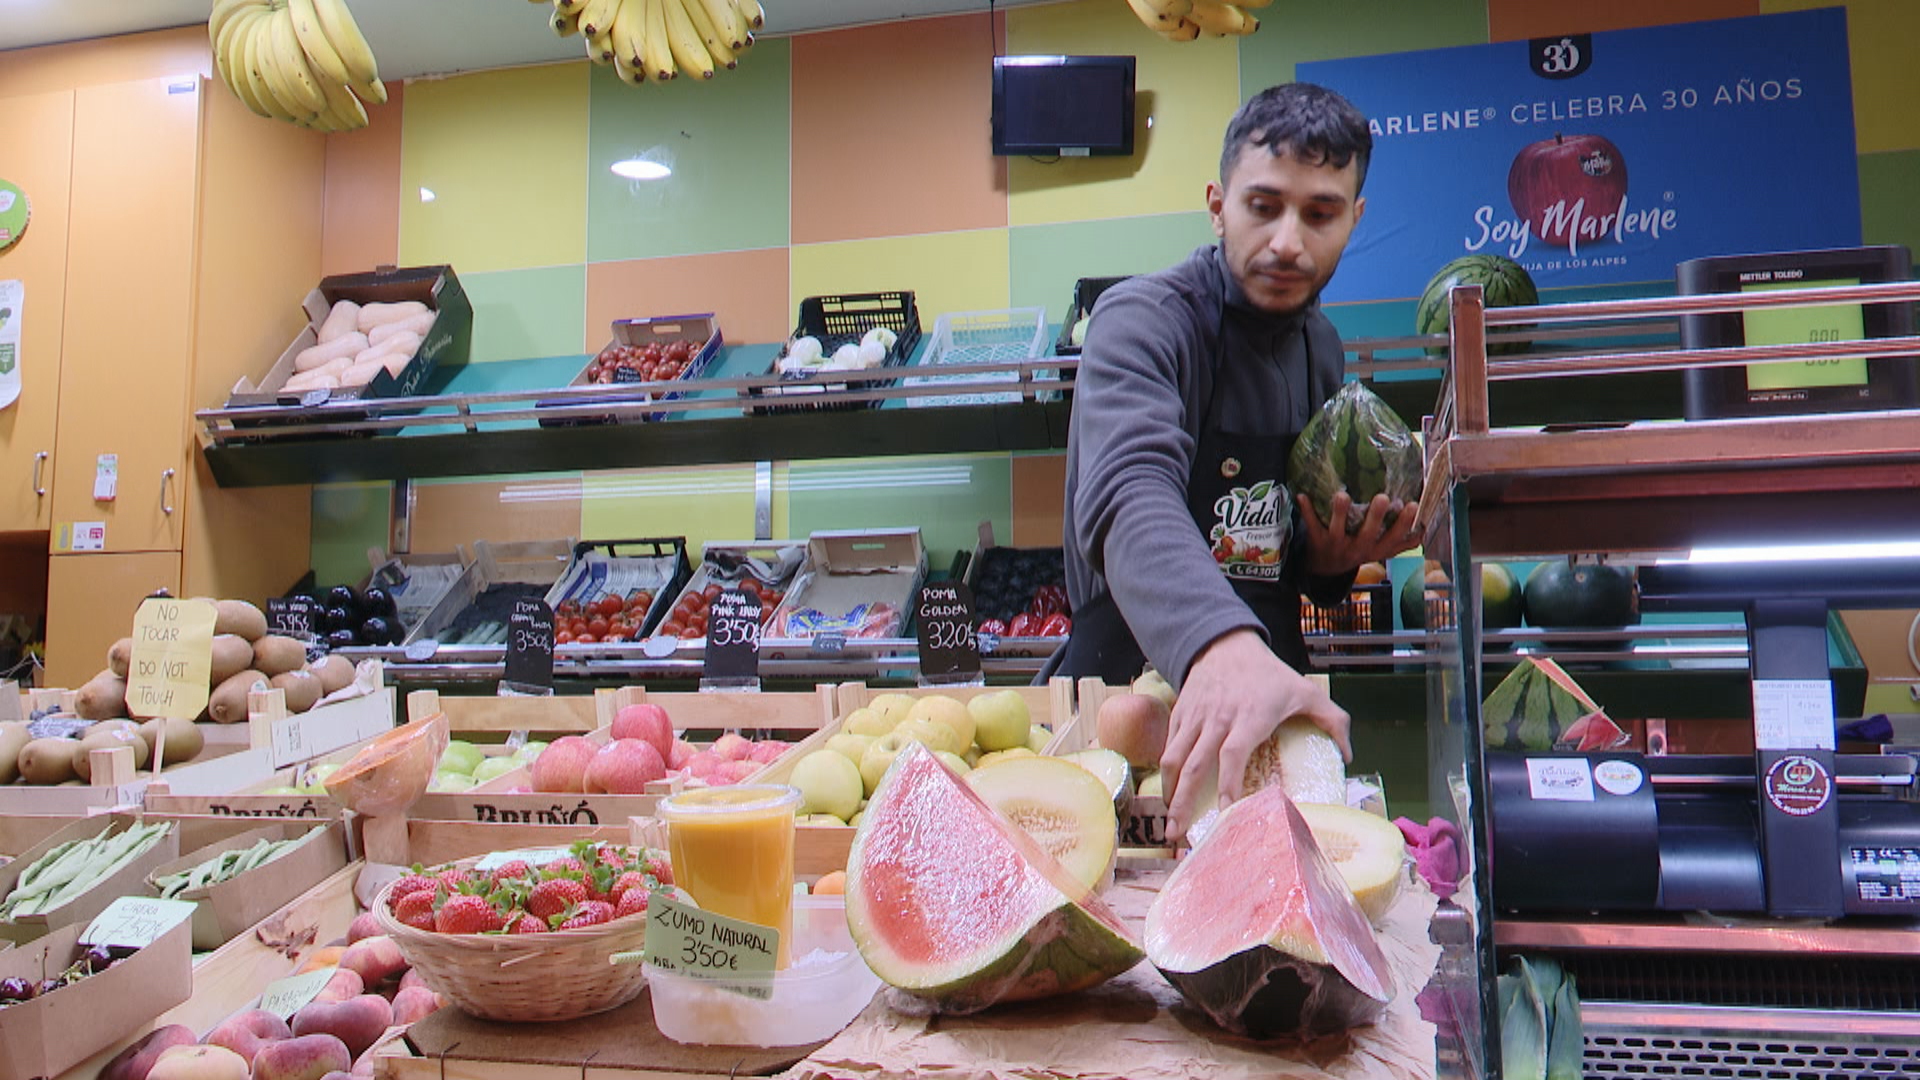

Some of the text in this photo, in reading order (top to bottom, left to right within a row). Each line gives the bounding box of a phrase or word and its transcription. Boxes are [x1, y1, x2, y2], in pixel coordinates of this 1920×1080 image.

[1543, 38, 1580, 72] 30
[1368, 77, 1802, 136] ARLENE® CELEBRA 30 AÑOS
[1465, 205, 1531, 258] Soy
[1566, 259, 1587, 268] LOS
[1592, 256, 1627, 267] ALPES
[1739, 270, 1803, 282] METTLER TOLEDO
[720, 593, 747, 606] POMA
[922, 587, 957, 601] POMA
[157, 604, 179, 621] NO
[516, 601, 540, 613] POMA
[711, 603, 762, 618] PINK LADY
[920, 603, 968, 617] GOLDEN
[141, 626, 180, 641] TOCAR
[139, 660, 188, 678] DO NOT
[138, 686, 174, 706] TOUCH
[654, 904, 772, 955] ZUMO NATURAL
[681, 936, 738, 971] 3'50€
